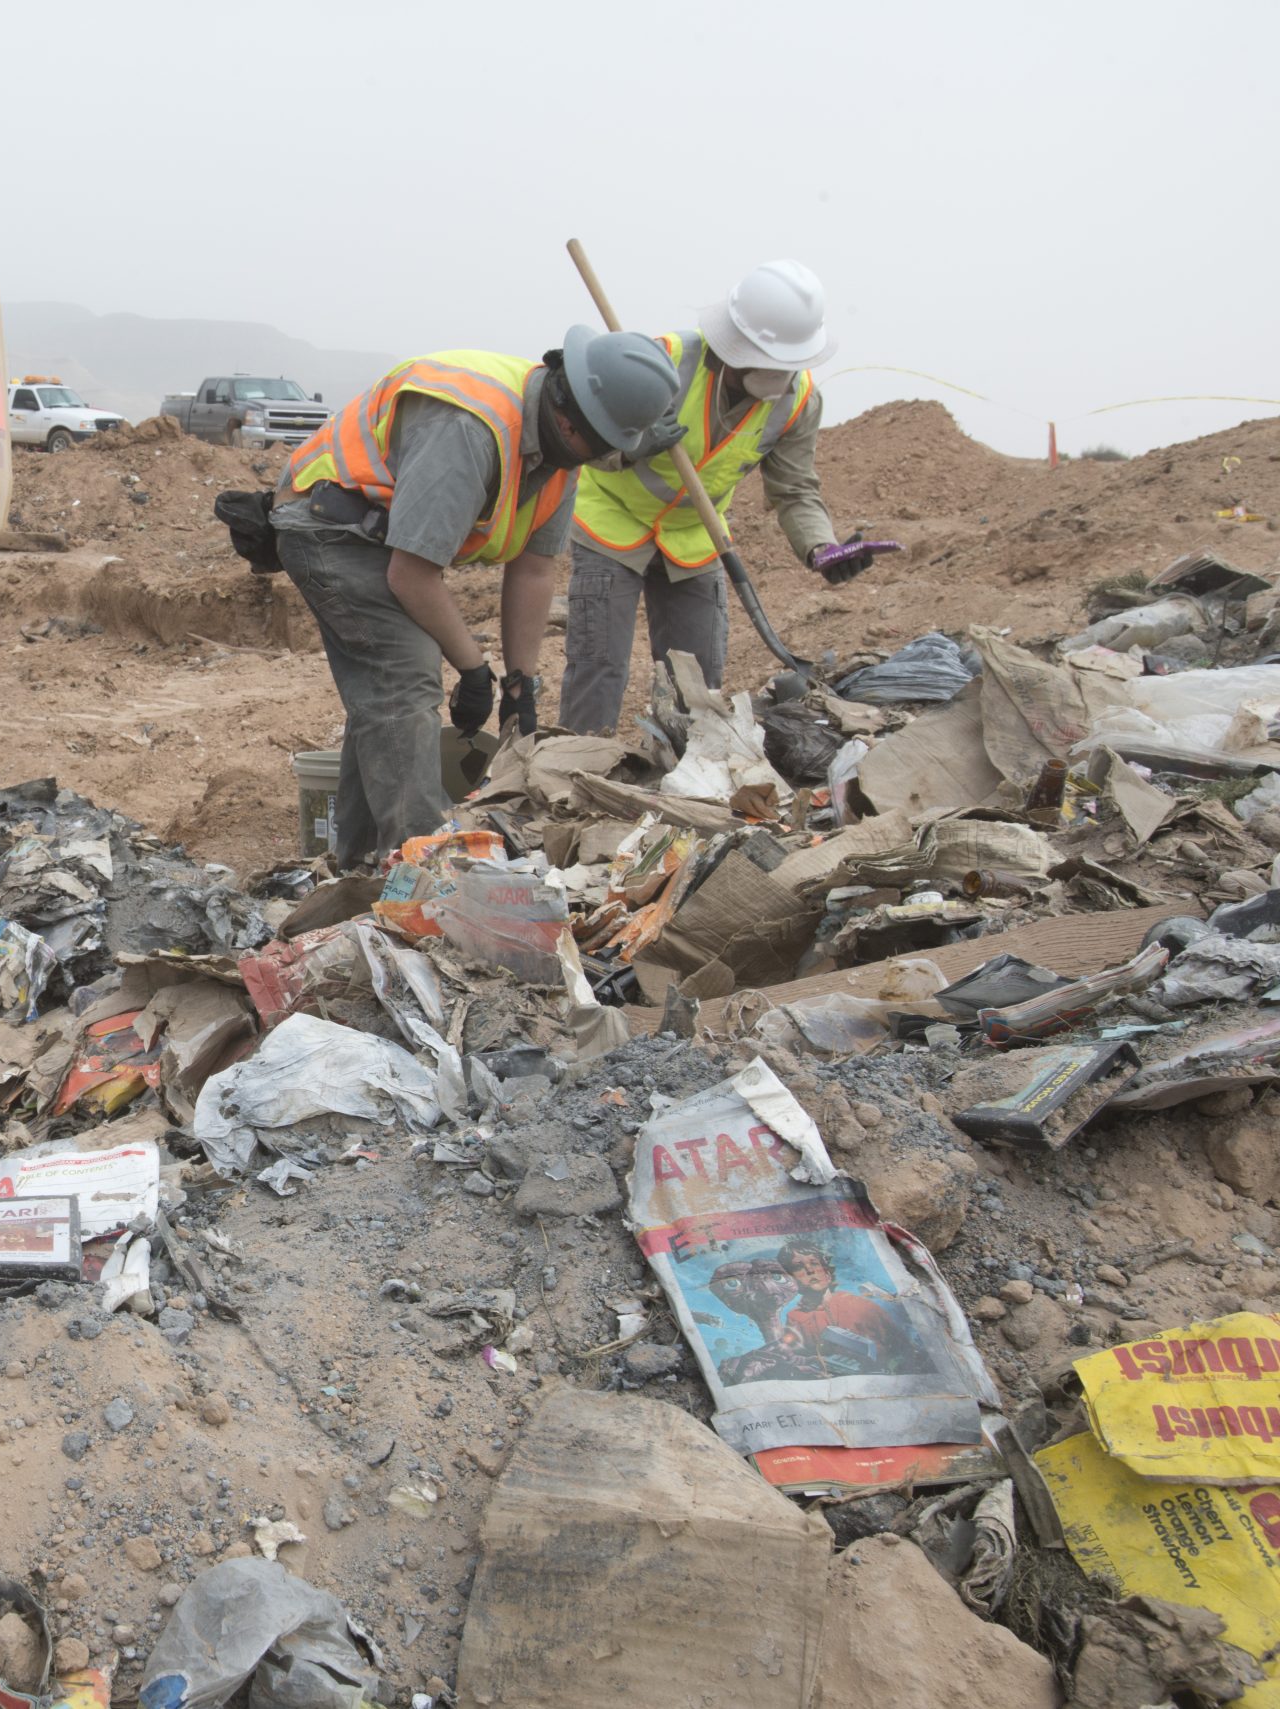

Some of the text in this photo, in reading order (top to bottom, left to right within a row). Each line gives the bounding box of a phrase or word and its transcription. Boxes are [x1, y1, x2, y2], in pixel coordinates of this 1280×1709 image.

[652, 1126, 788, 1187] ATAR
[1080, 1523, 1100, 1544] NET
[1160, 1498, 1201, 1558] Orange
[1174, 1491, 1214, 1546] Lemon
[1194, 1487, 1233, 1542] Cherry
[1238, 1513, 1276, 1569] Chews
[1141, 1502, 1202, 1590] Strawberry
